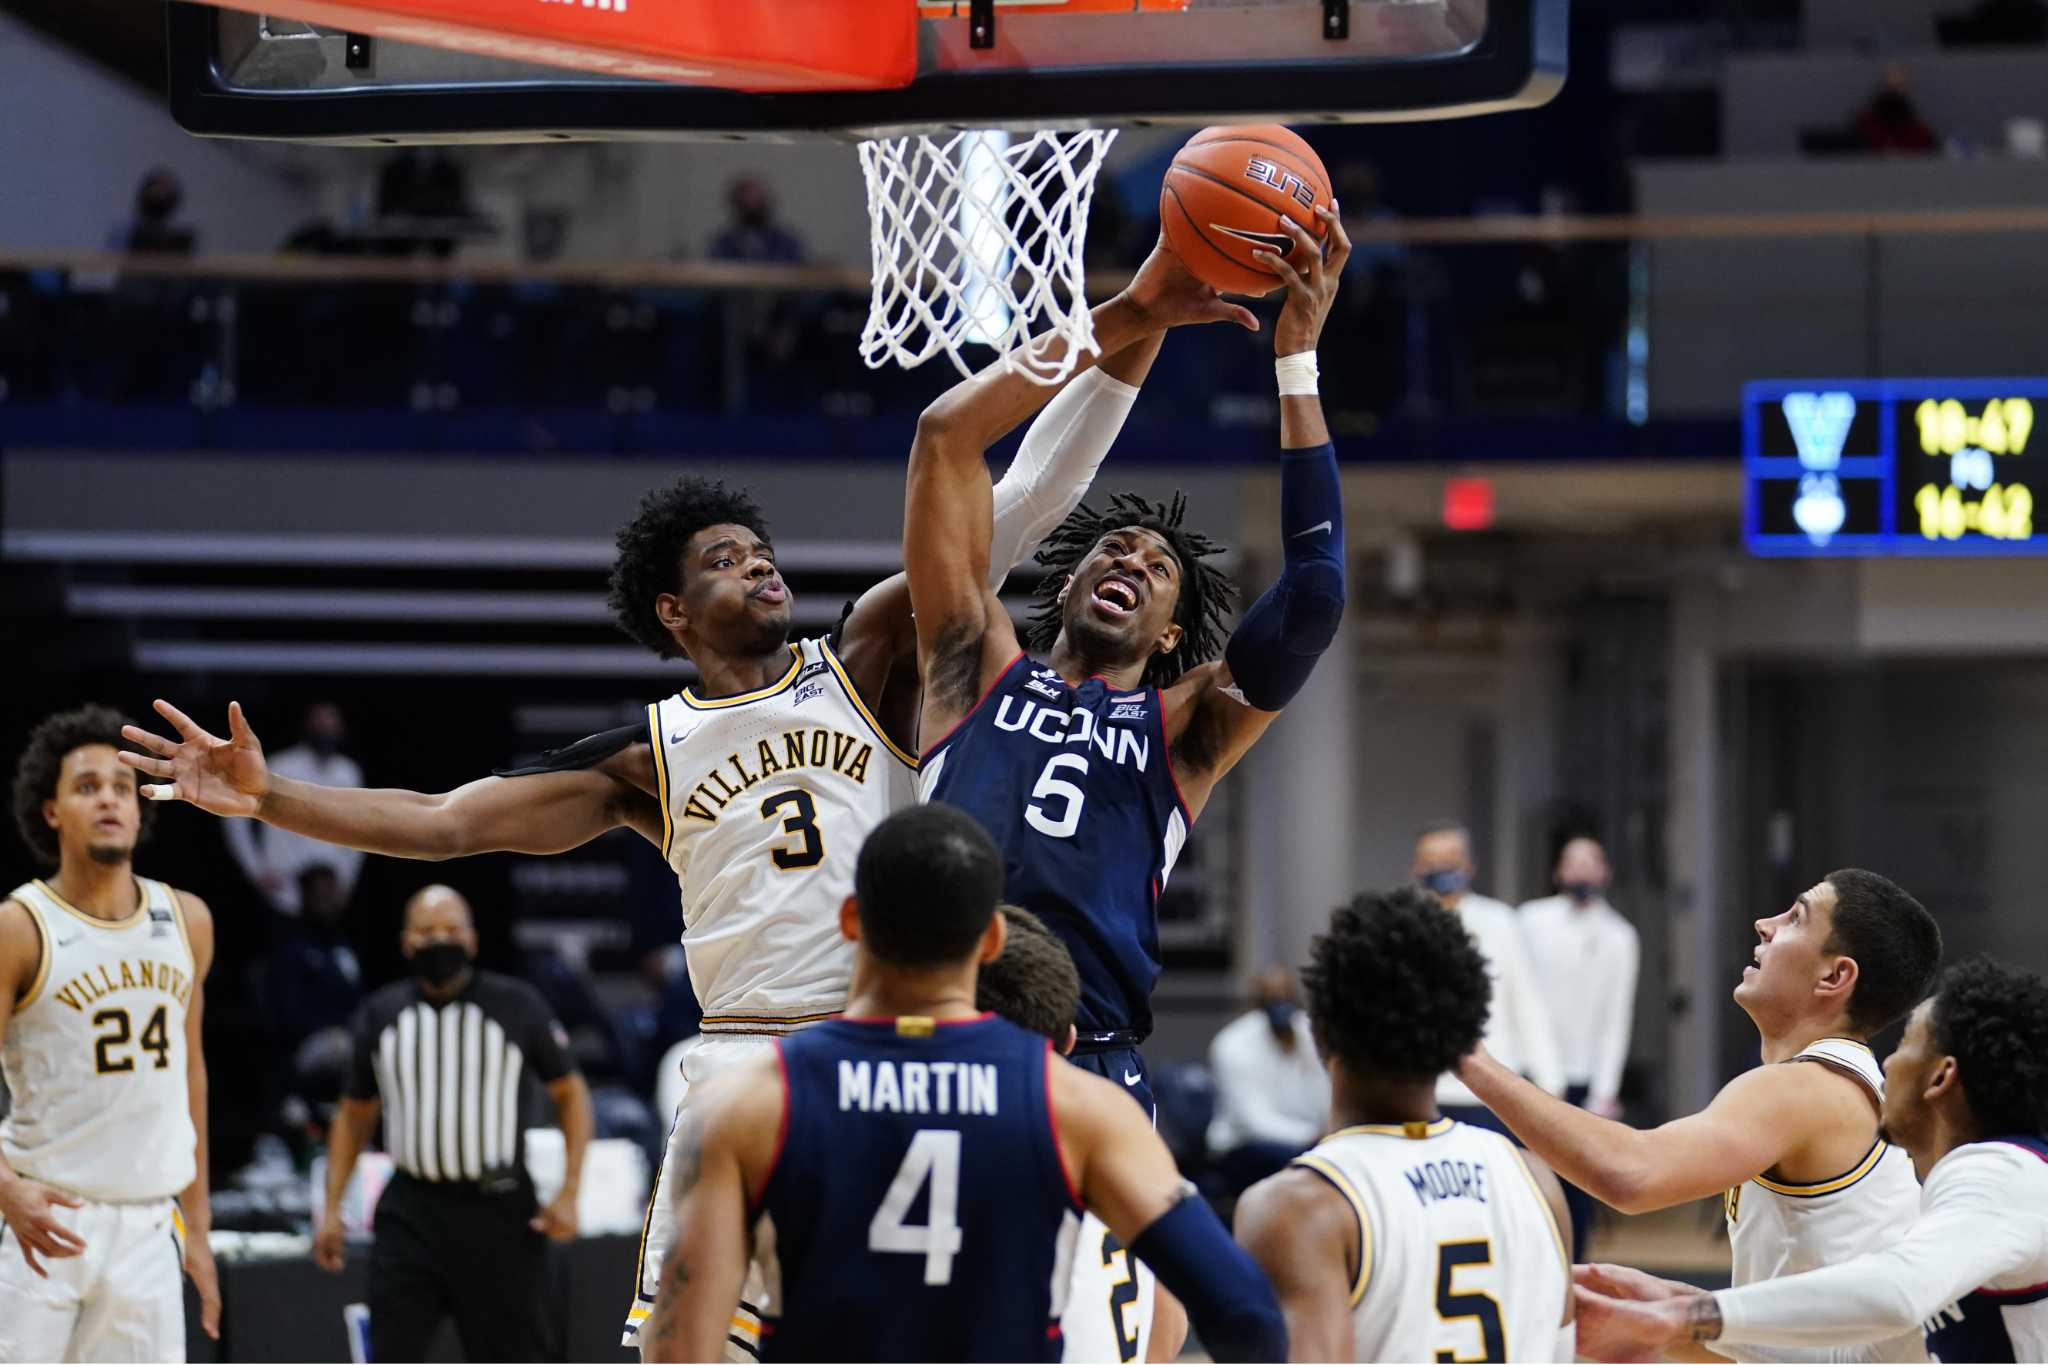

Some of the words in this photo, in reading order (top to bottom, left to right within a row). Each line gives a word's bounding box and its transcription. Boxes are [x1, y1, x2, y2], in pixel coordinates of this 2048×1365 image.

[994, 694, 1149, 773] UCONN
[1110, 711, 1148, 719] EAST
[684, 730, 874, 823] VILLANOVA
[1024, 753, 1089, 838] 5
[760, 788, 825, 871] 3
[92, 1004, 171, 1075] 24
[838, 1060, 999, 1116] MARTIN
[868, 1129, 962, 1286] 4
[1404, 1160, 1487, 1207] MOORE
[1434, 1236, 1507, 1364] 5
